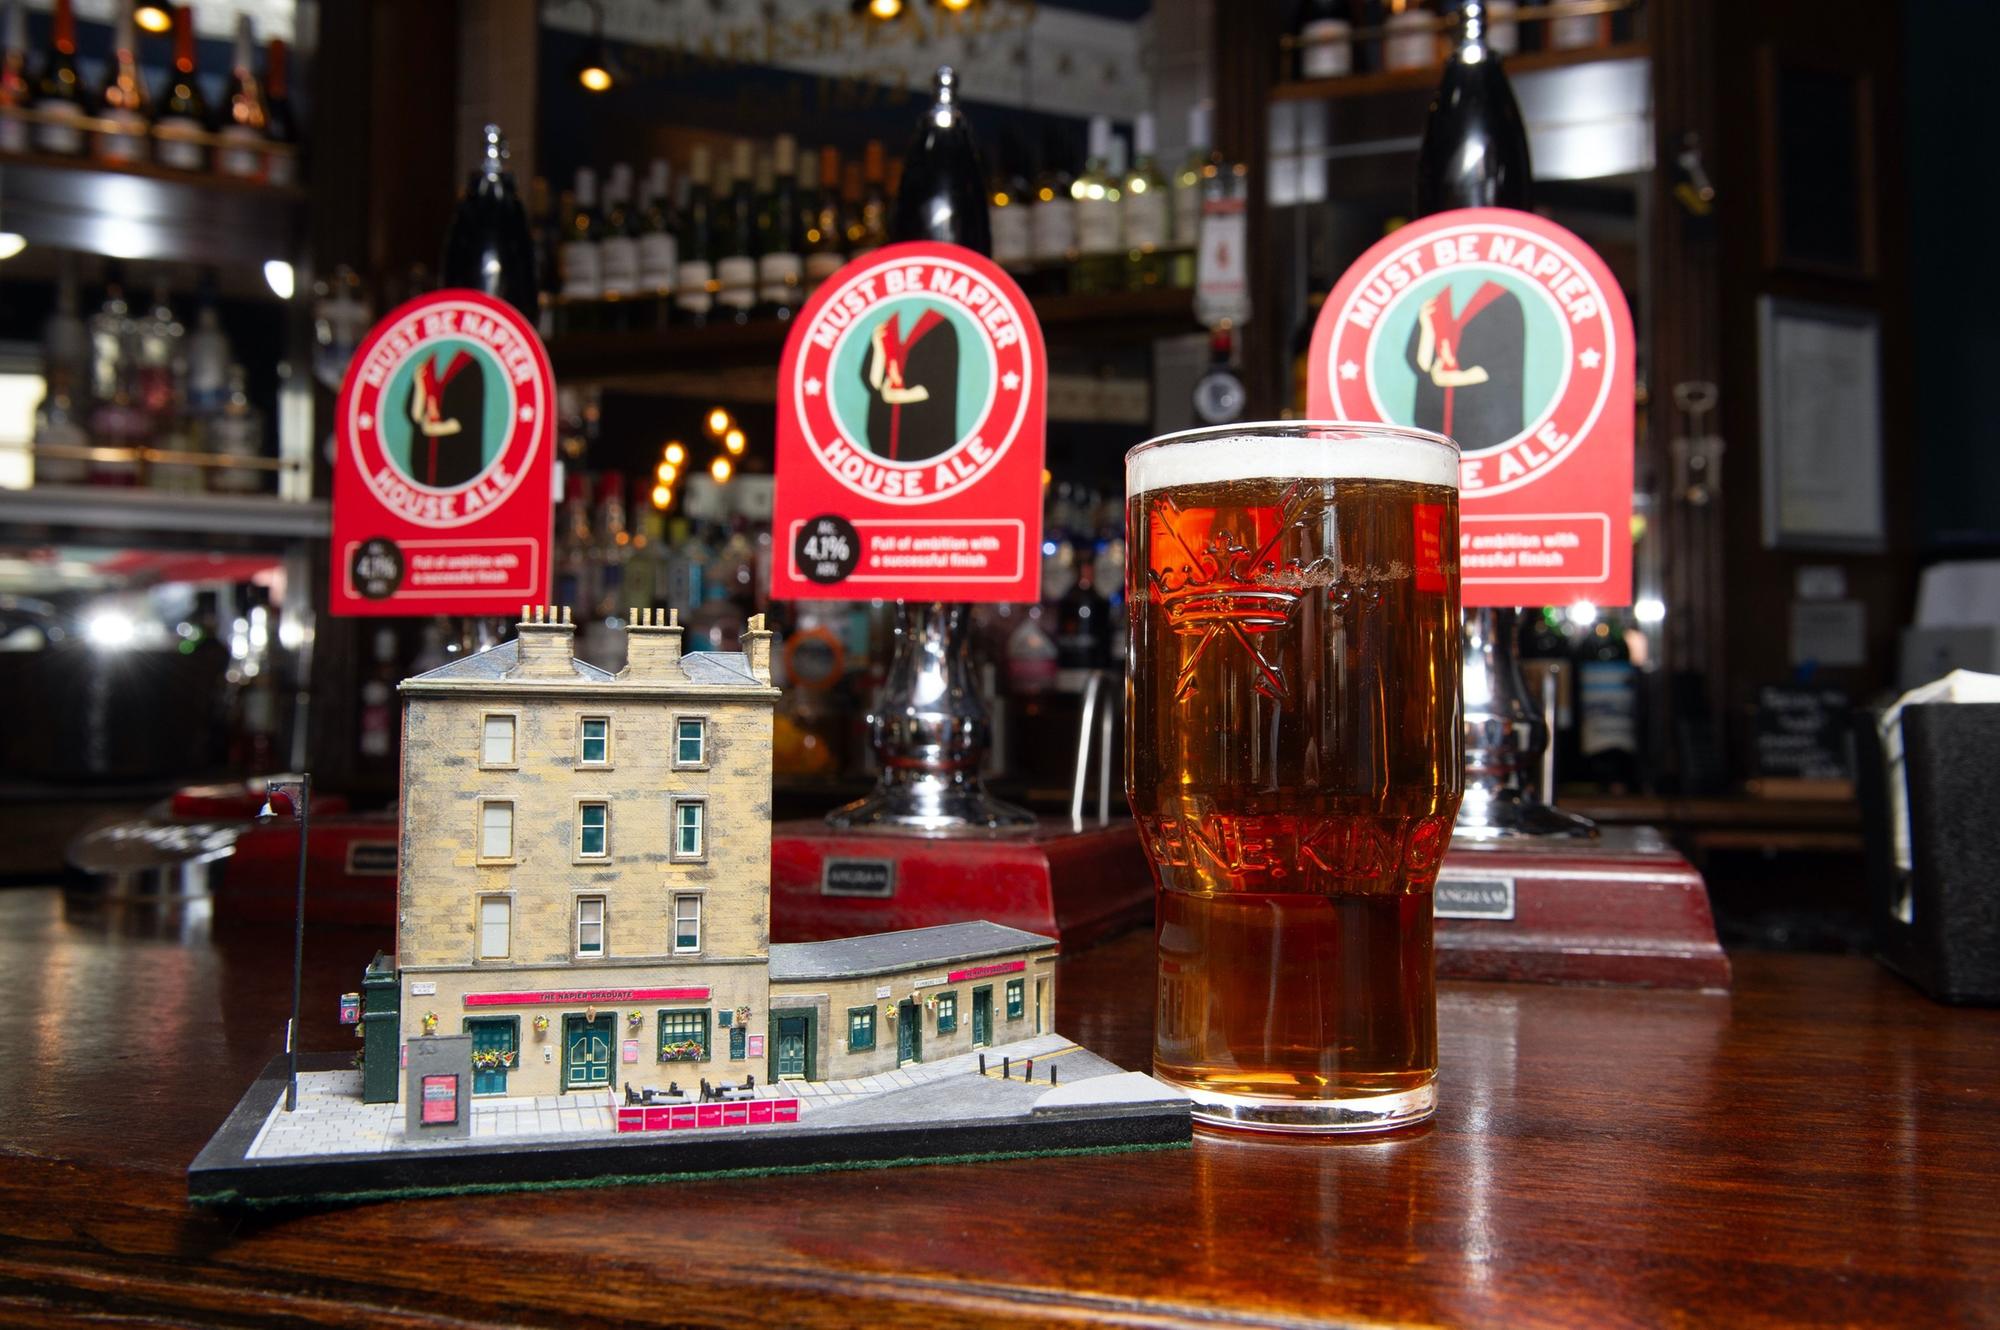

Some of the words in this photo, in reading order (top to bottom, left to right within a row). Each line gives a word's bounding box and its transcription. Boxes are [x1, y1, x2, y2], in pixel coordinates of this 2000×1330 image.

[813, 278, 877, 350] MUST
[884, 266, 924, 293] BE
[929, 267, 1019, 350] NAPIER
[1348, 251, 1423, 330] MUST
[1433, 234, 1479, 265] BE
[1488, 235, 1600, 325] NAPIER
[366, 319, 419, 389] MUST
[423, 311, 459, 337] BE
[461, 311, 534, 386] NAPIER
[823, 438, 924, 497] HOUSE
[935, 436, 993, 490] ALE
[1499, 421, 1569, 482] ALE
[374, 466, 458, 520] HOUSE
[464, 462, 514, 514] ALE
[870, 556, 880, 567] a
[882, 553, 948, 567] successful
[950, 553, 987, 567] finish
[871, 536, 896, 550] Full
[897, 536, 911, 550] of
[912, 536, 969, 550] ambition
[970, 536, 999, 550] with
[1461, 551, 1517, 567] cessful
[1518, 551, 1564, 567] finish
[1472, 532, 1541, 549] ambition
[1542, 531, 1579, 548] with
[540, 992, 555, 1000] THE
[558, 992, 587, 1000] NAPIER
[590, 991, 632, 999] GRADUATE
